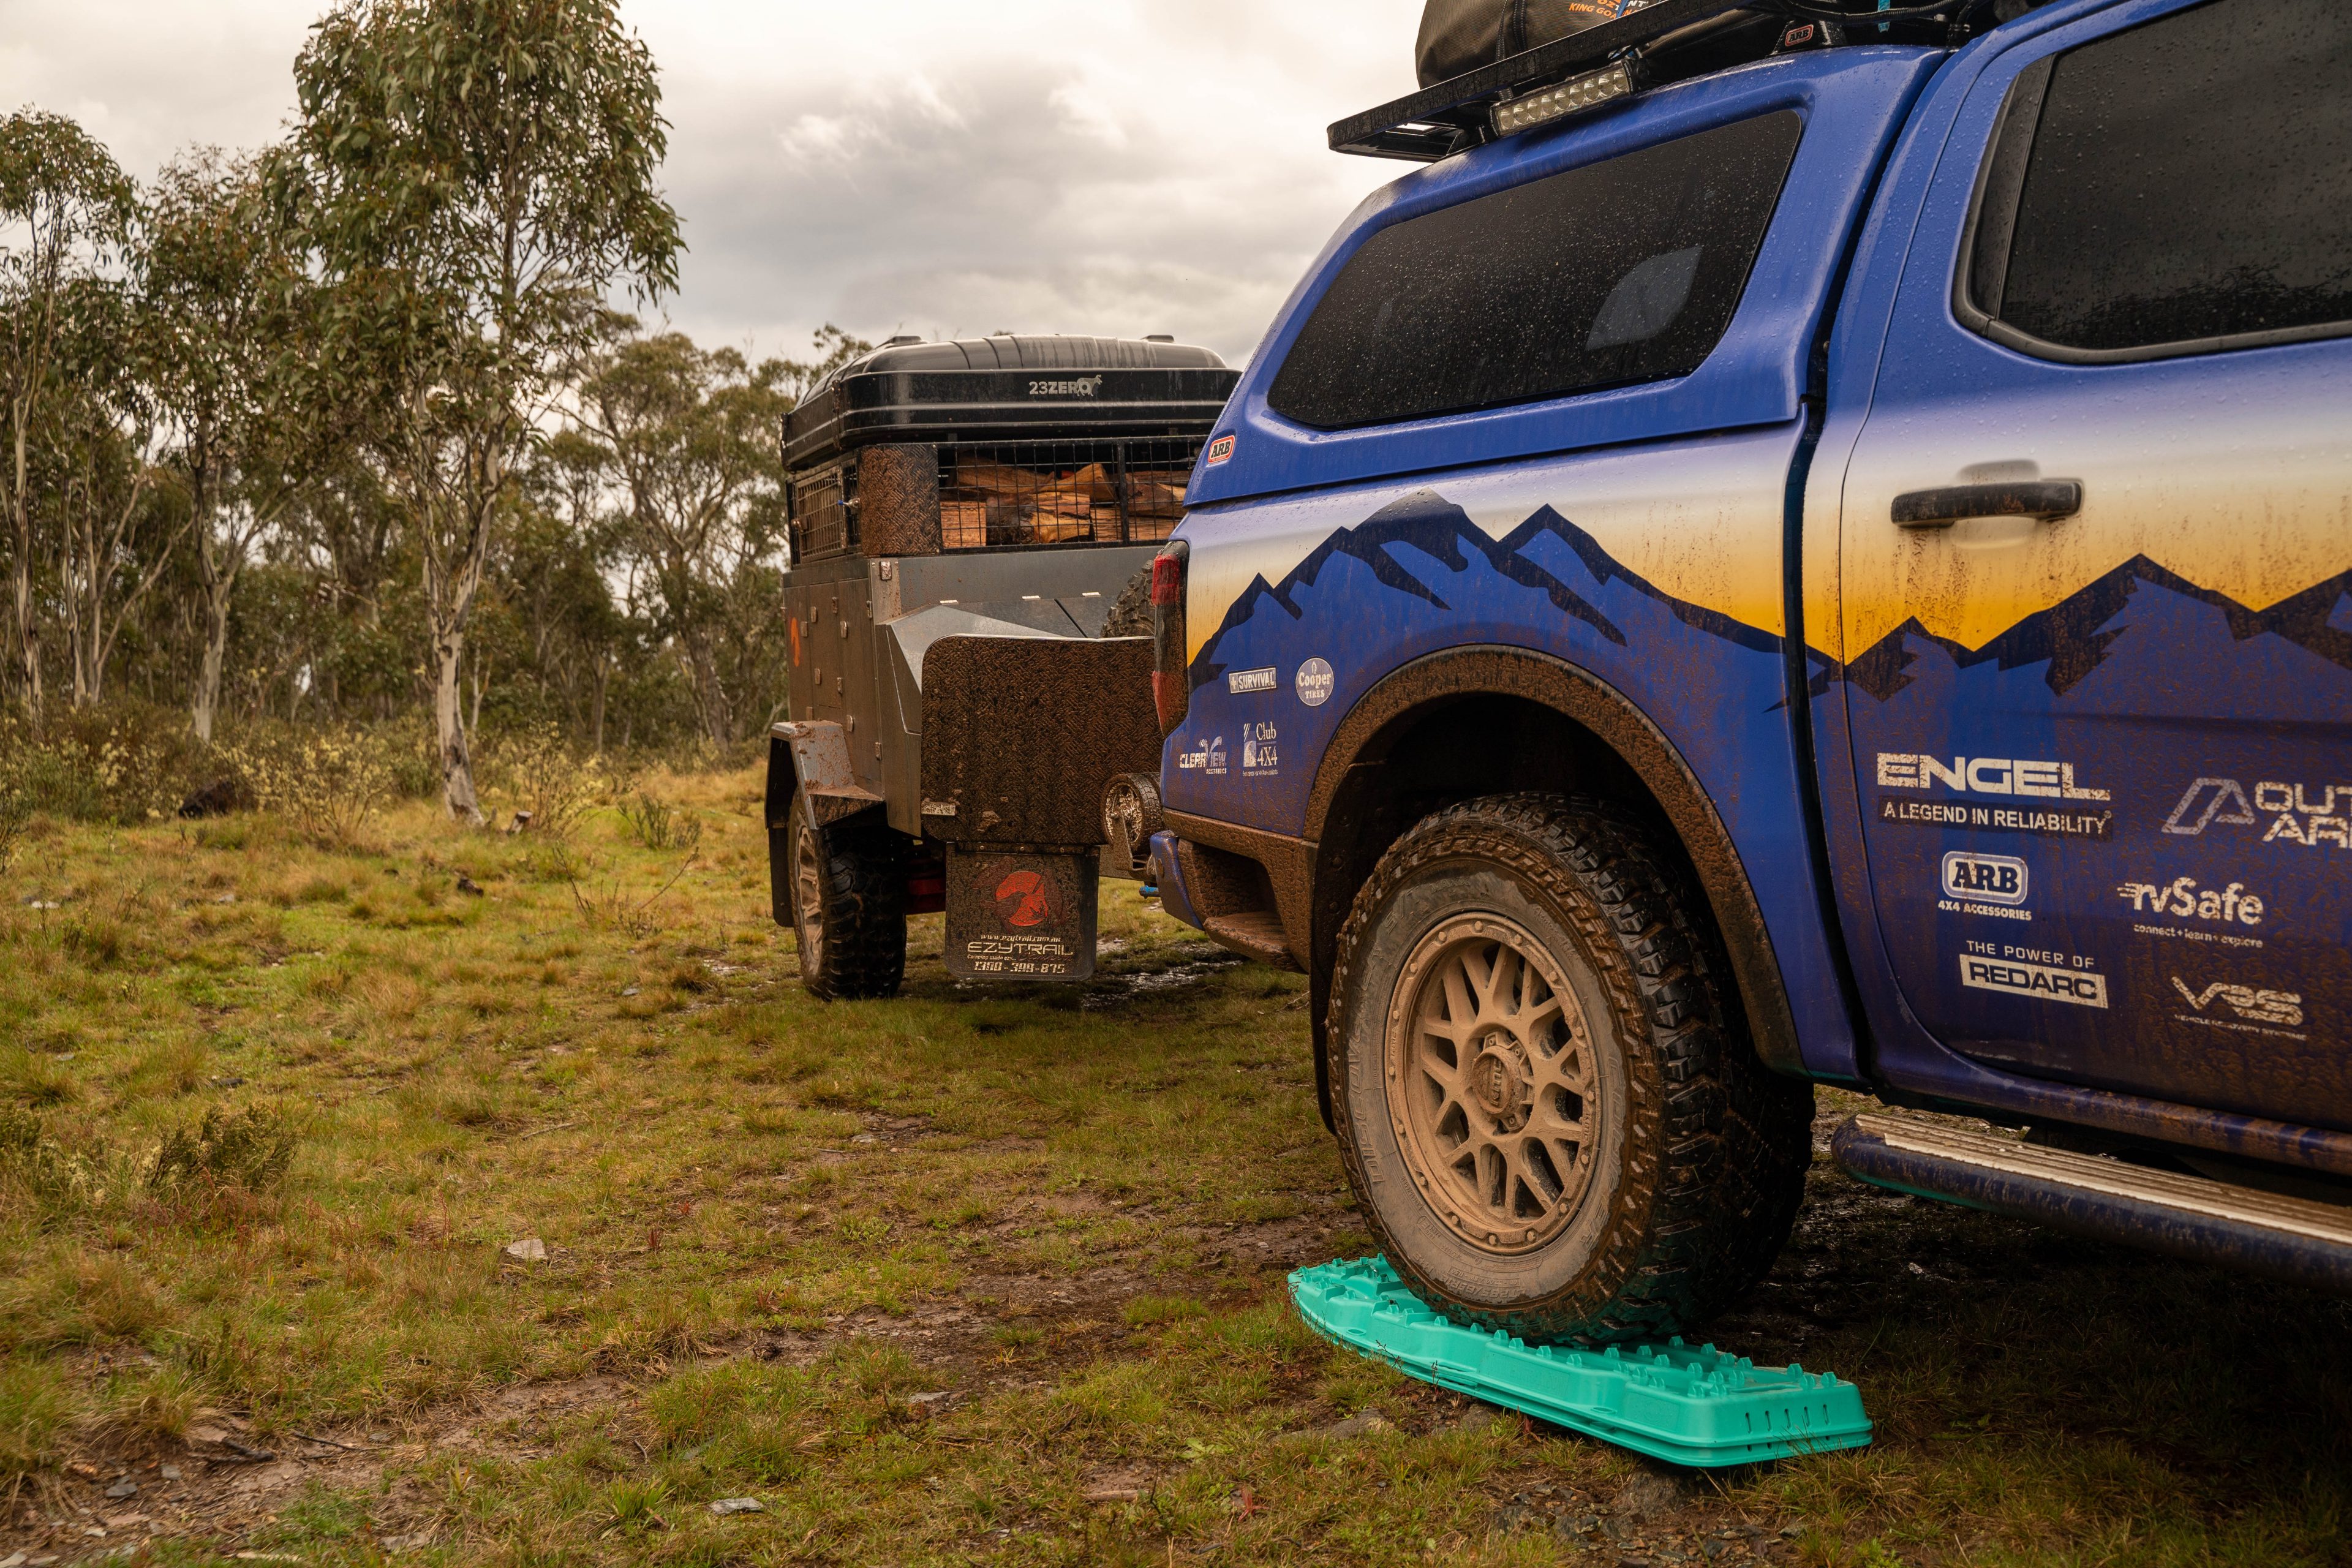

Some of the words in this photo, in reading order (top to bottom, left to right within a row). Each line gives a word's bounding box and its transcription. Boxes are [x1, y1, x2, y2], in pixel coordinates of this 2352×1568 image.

[1569, 2, 1595, 12] KING
[1029, 381, 1091, 395] 23ZERO
[1210, 440, 1231, 458] ARB
[1238, 671, 1275, 690] SURVIVAL
[1298, 672, 1332, 689] Cooper
[1305, 689, 1325, 698] TIRES
[1256, 722, 1276, 741] Club
[1877, 752, 2111, 801] ENGEL
[1884, 802, 1896, 818] A
[1899, 804, 1967, 824] LEGEND
[1972, 807, 1989, 825] IN
[2261, 812, 2352, 849] AR
[1952, 861, 2019, 894] ARB
[1963, 903, 2032, 921] ACCESSORIES
[2134, 924, 2176, 937] connect
[2184, 928, 2212, 942] learn
[967, 941, 1074, 956] EZYTRAIL
[1966, 940, 1996, 955] THE
[2004, 945, 2064, 965] POWER
[2072, 956, 2095, 969] OF
[1969, 962, 2098, 1000] REDARC
